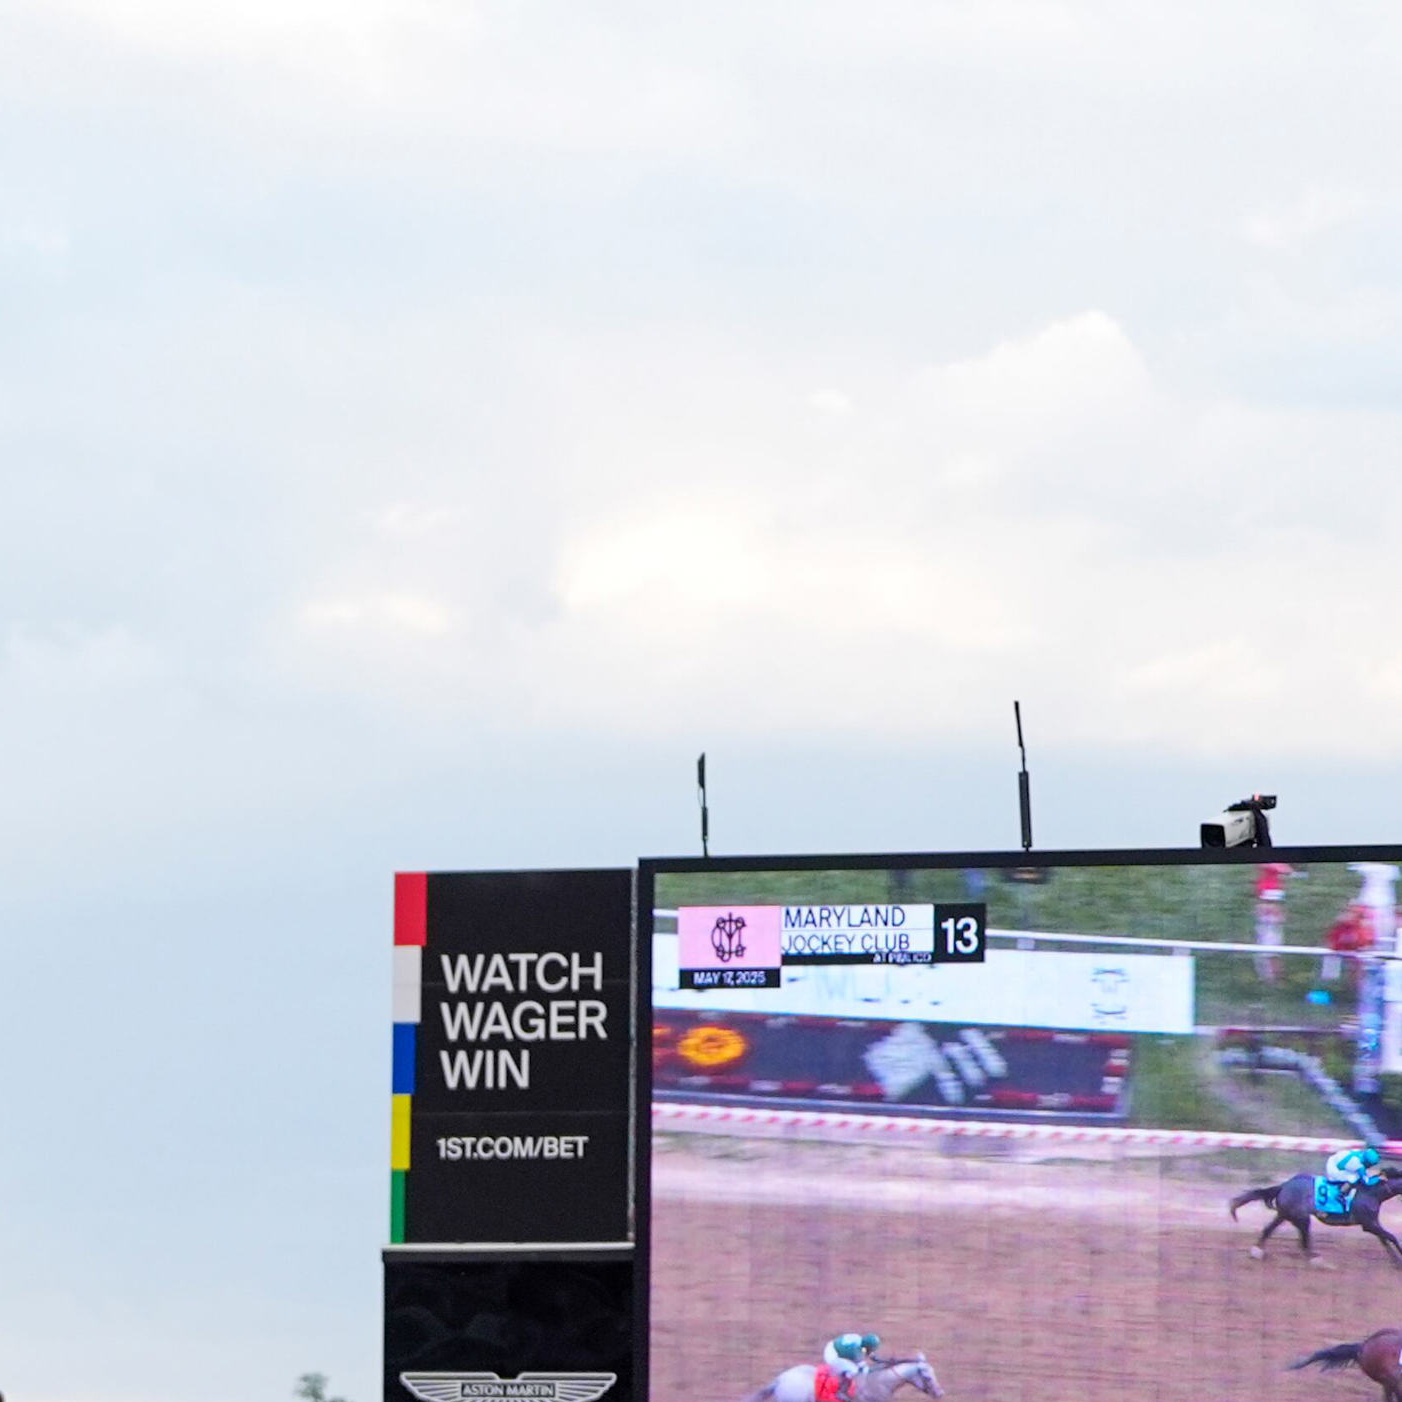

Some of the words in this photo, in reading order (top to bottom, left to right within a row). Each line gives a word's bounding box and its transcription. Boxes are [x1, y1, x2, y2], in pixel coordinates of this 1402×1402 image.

[784, 906, 906, 928] MARYLAND
[782, 934, 855, 952] JOCKEY
[861, 933, 911, 952] CLUB
[941, 916, 979, 954] 13
[441, 951, 603, 993] WATCH
[693, 970, 721, 985] MAY
[440, 1000, 608, 1042] WAGER
[439, 1049, 530, 1090] WIN
[437, 1135, 589, 1160] 1ST.COM/BET
[463, 1384, 505, 1397] ASTON
[506, 1384, 555, 1397] MARTIN
